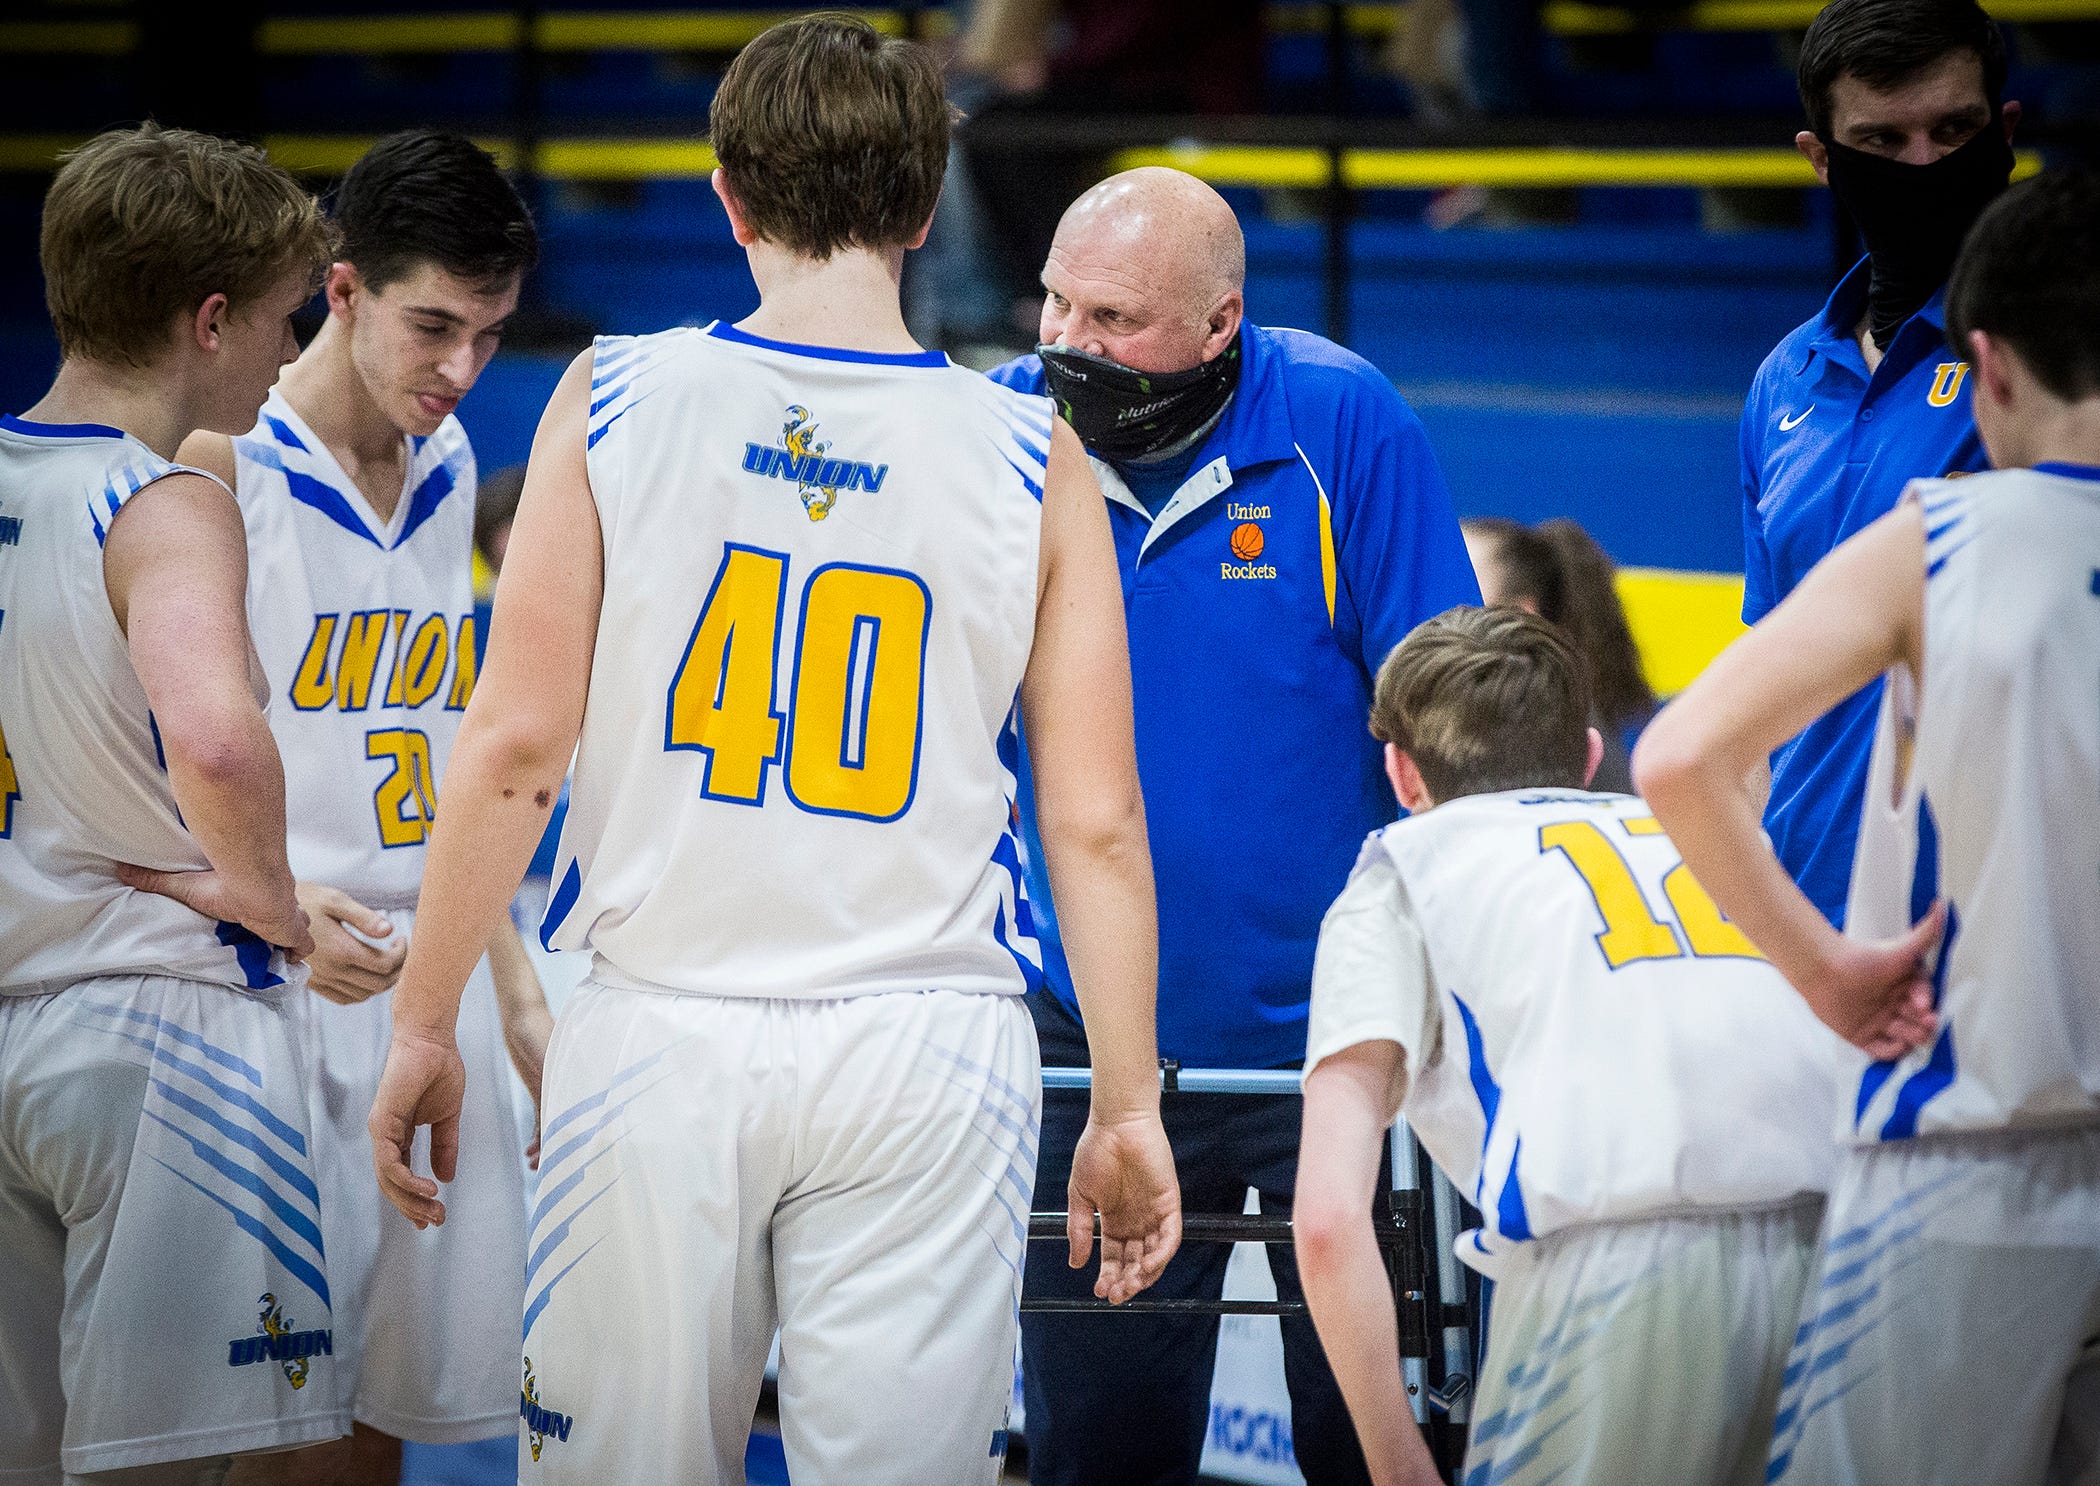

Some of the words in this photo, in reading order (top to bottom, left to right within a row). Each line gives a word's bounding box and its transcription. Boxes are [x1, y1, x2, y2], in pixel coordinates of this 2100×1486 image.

[1927, 362, 1970, 407] U
[742, 442, 889, 493] UNION
[1227, 503, 1271, 520] Union
[1220, 561, 1277, 580] Rockets
[663, 541, 933, 824] 40
[229, 1329, 332, 1367] UNION
